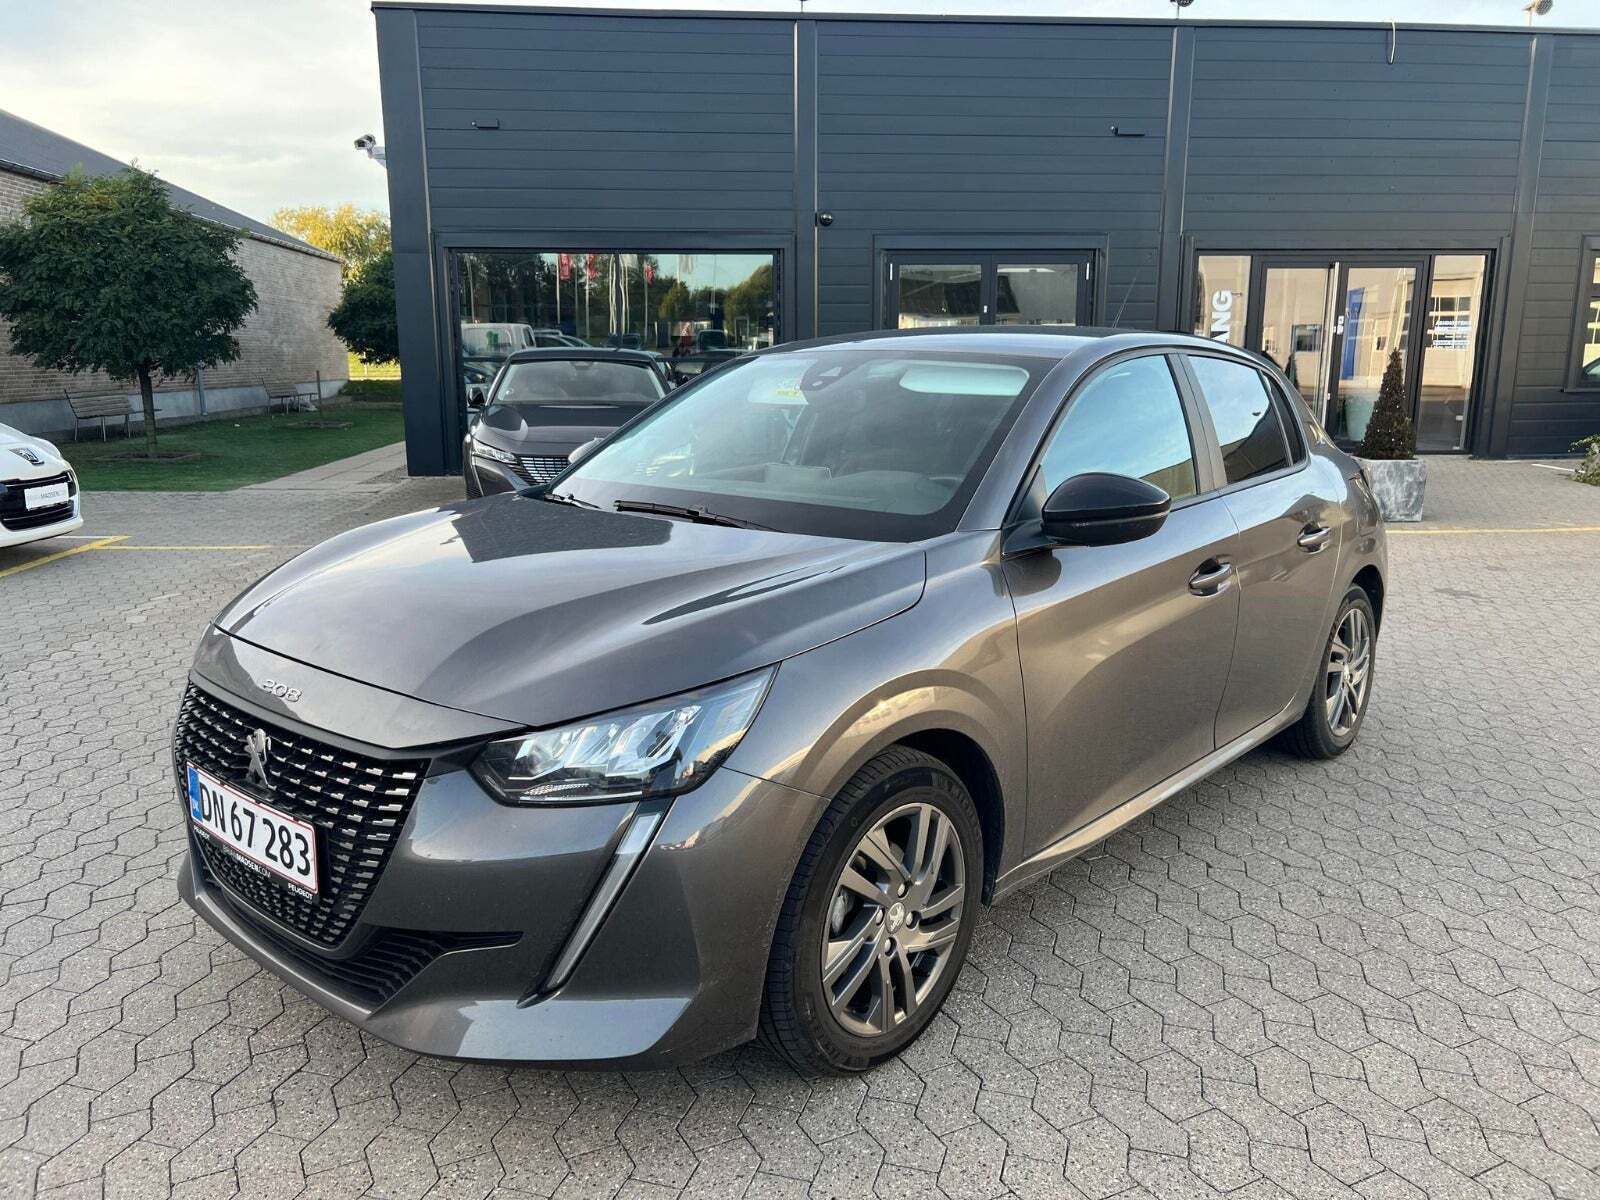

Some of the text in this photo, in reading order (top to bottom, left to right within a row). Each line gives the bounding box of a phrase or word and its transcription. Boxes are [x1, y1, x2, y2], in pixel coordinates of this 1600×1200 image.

[263, 679, 302, 702] 208
[199, 782, 311, 876] DN 67 283
[288, 883, 313, 900] PEUGEOT
